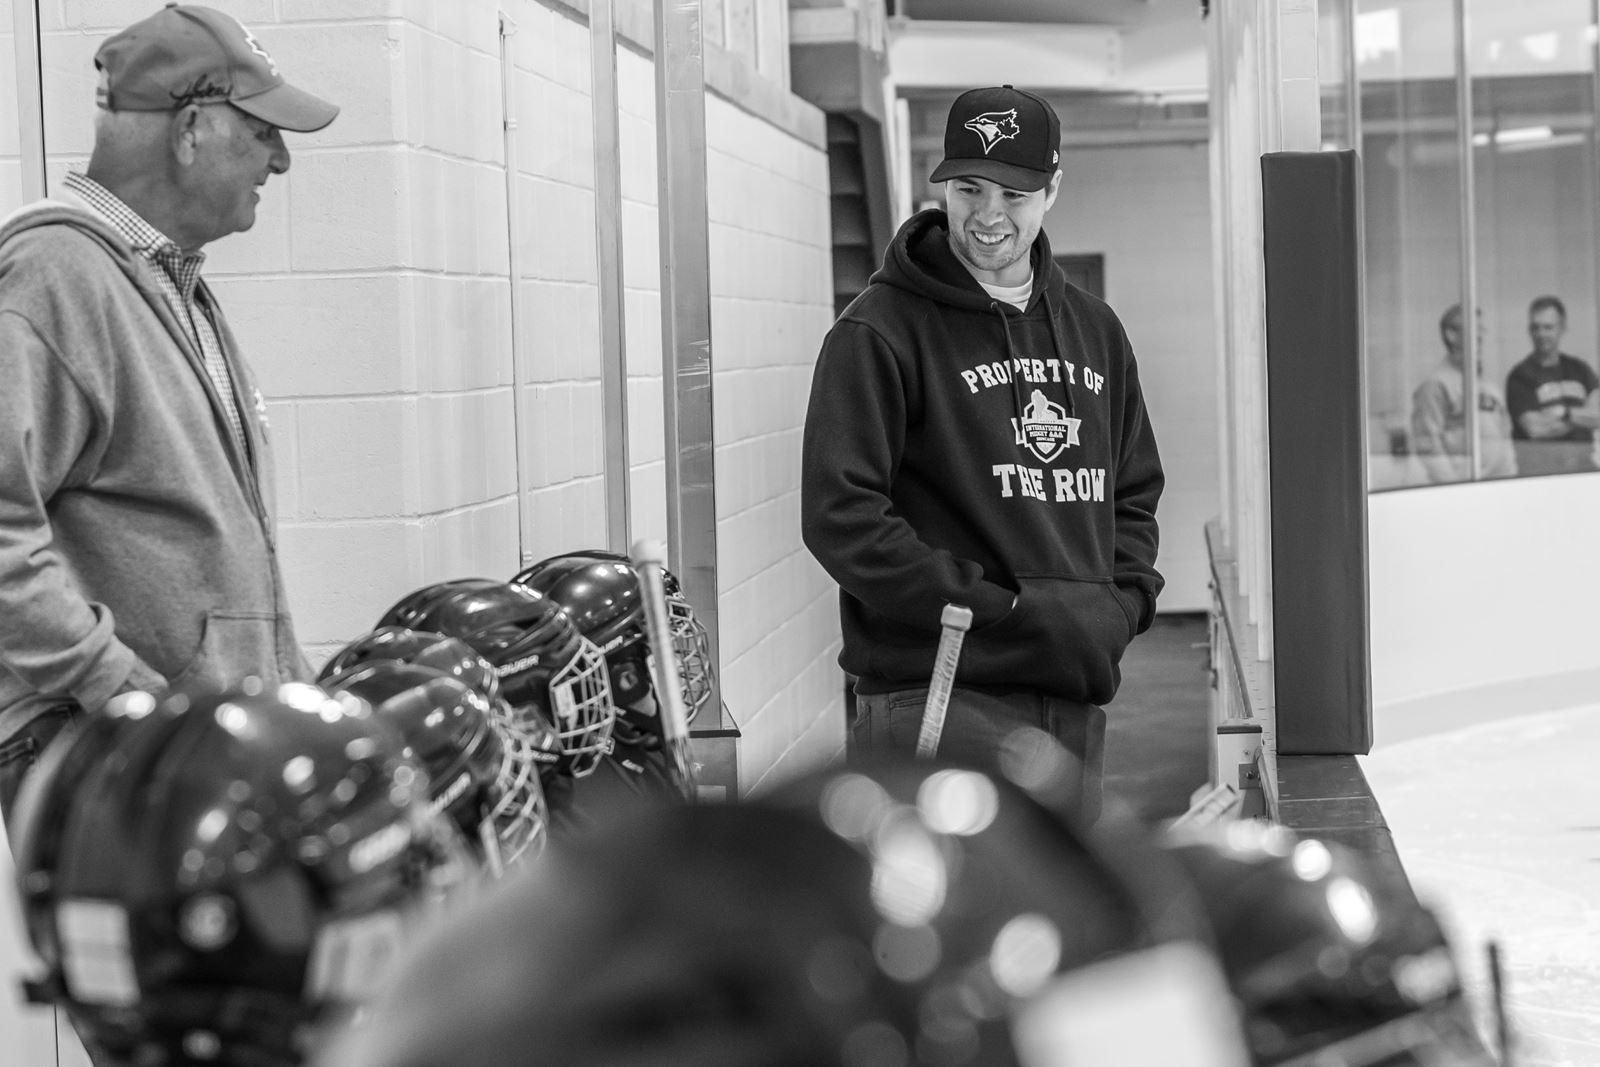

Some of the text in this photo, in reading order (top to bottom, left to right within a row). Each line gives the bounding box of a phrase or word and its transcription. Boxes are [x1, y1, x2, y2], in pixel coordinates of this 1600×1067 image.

[961, 358, 1104, 395] PROPERTY OF
[992, 464, 1105, 502] THE ROW
[497, 654, 539, 678] AUER
